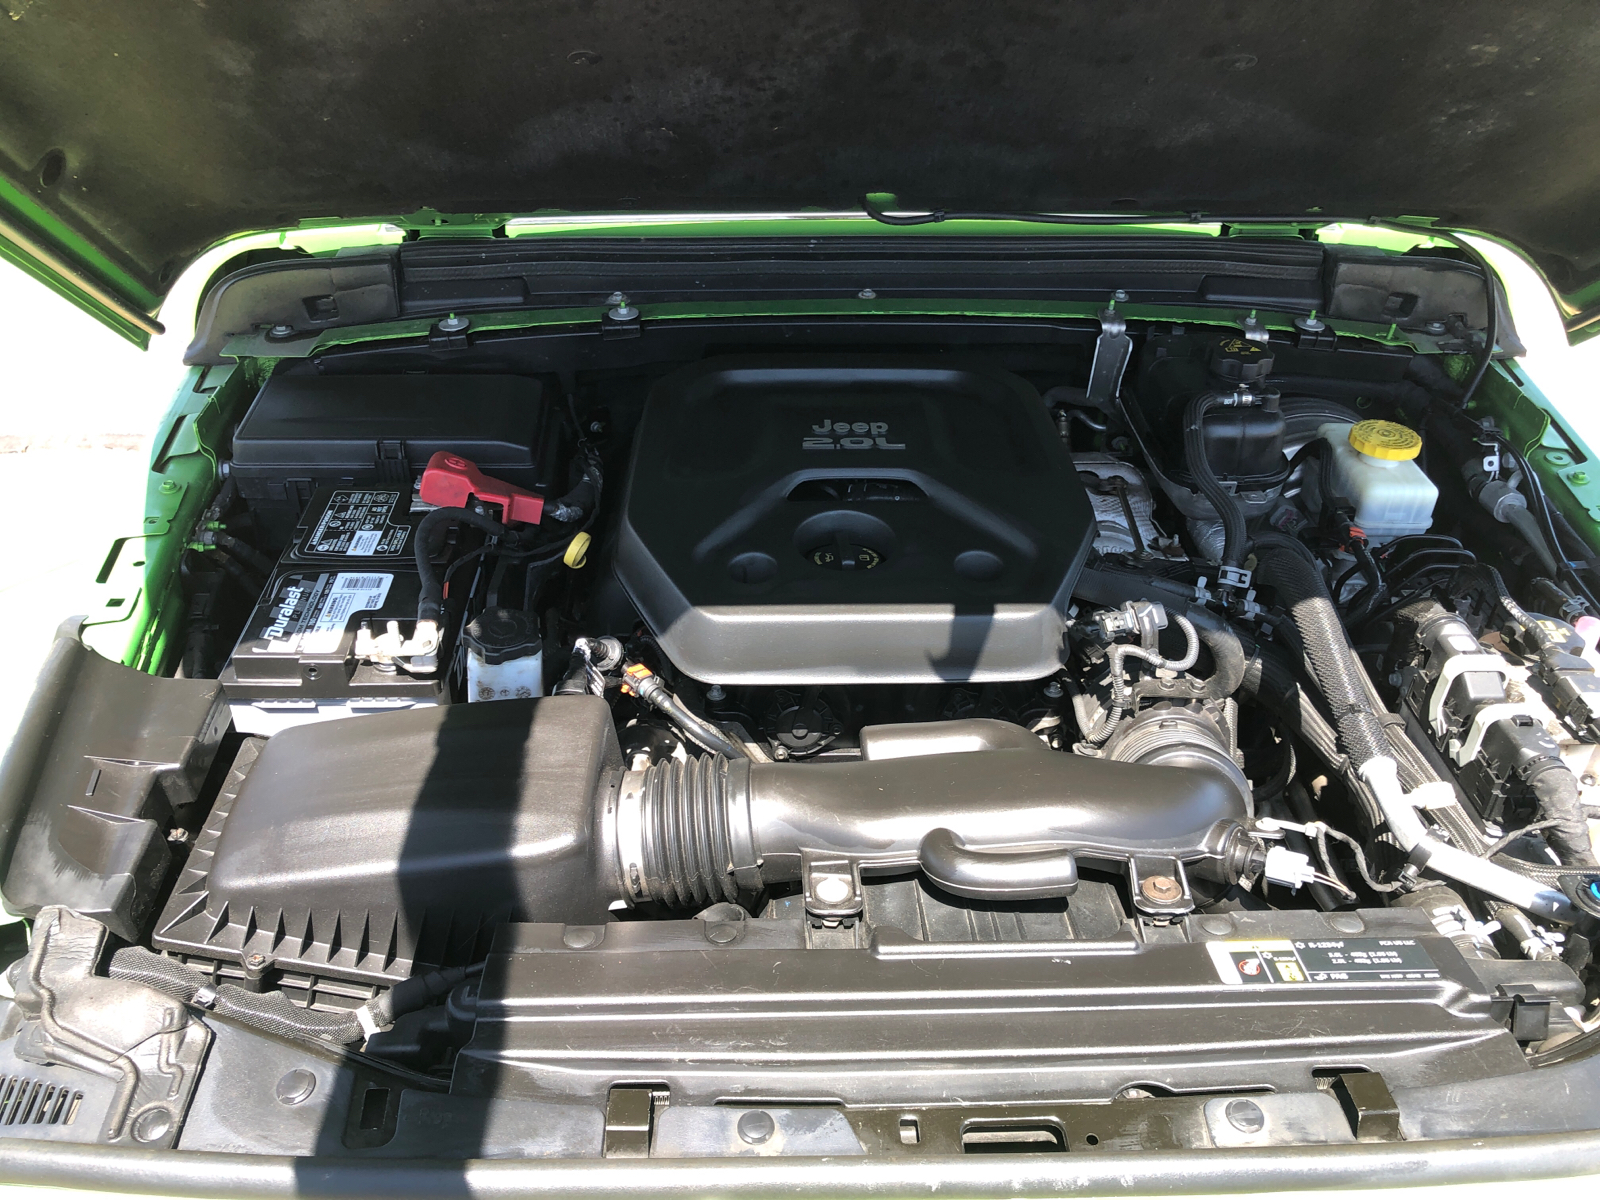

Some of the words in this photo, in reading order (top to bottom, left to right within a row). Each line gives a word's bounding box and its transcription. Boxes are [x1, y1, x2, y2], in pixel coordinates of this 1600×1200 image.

[812, 419, 889, 437] Jeep
[802, 437, 906, 449] 2.0L
[264, 585, 305, 640] Duralast
[301, 589, 320, 625] TECHNOLOGY
